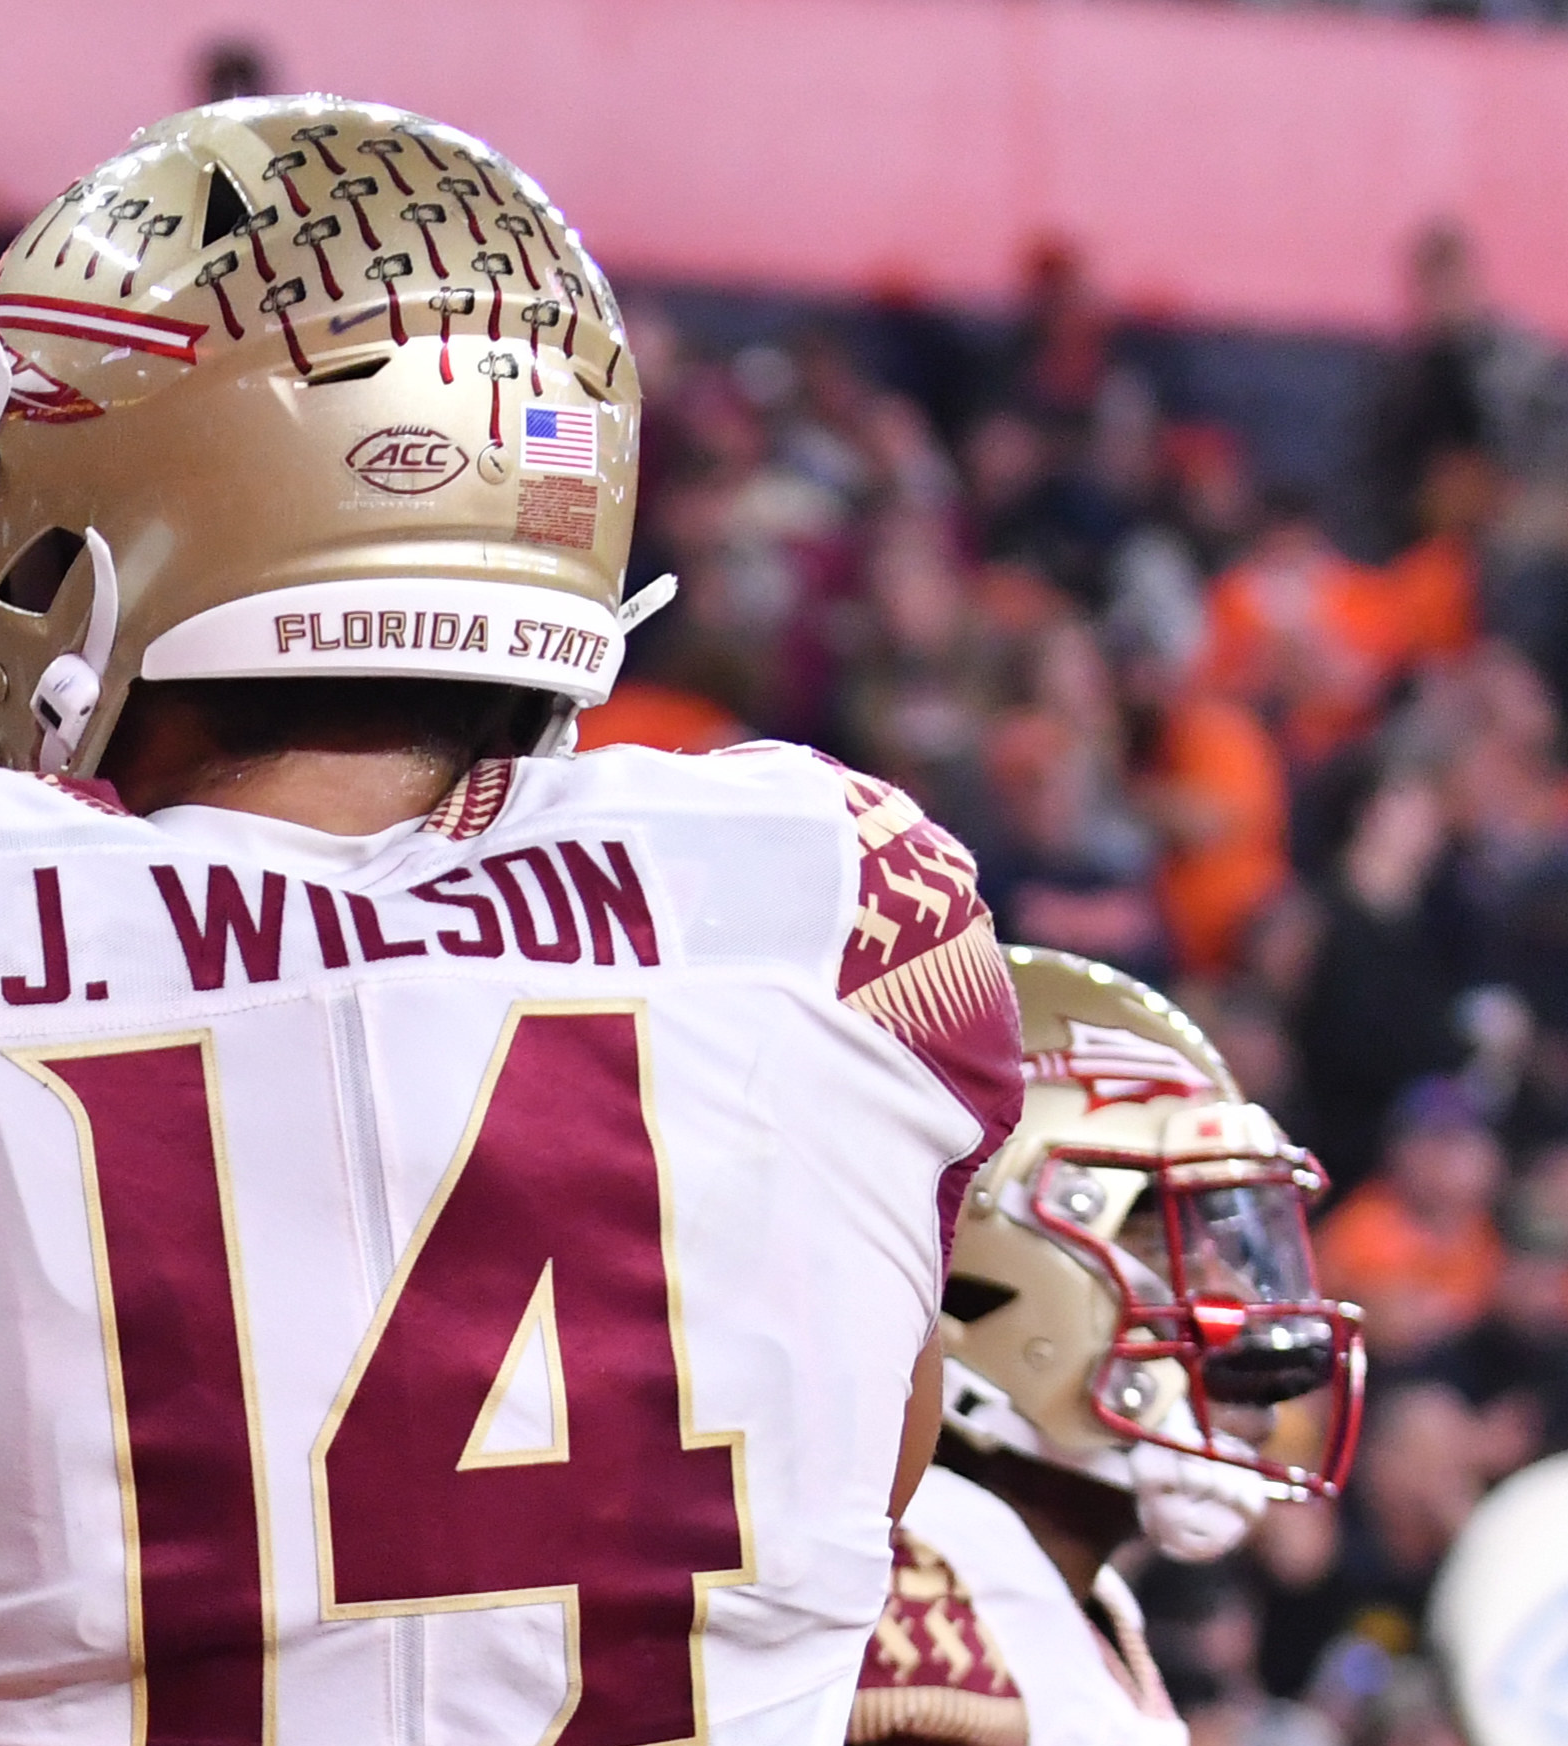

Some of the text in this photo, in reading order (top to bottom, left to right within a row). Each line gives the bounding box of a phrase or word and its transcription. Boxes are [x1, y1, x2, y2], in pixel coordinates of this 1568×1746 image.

[366, 443, 451, 466] ACC
[274, 610, 609, 673] FLORIDA STATE
[1, 839, 660, 1006] J. WILSON
